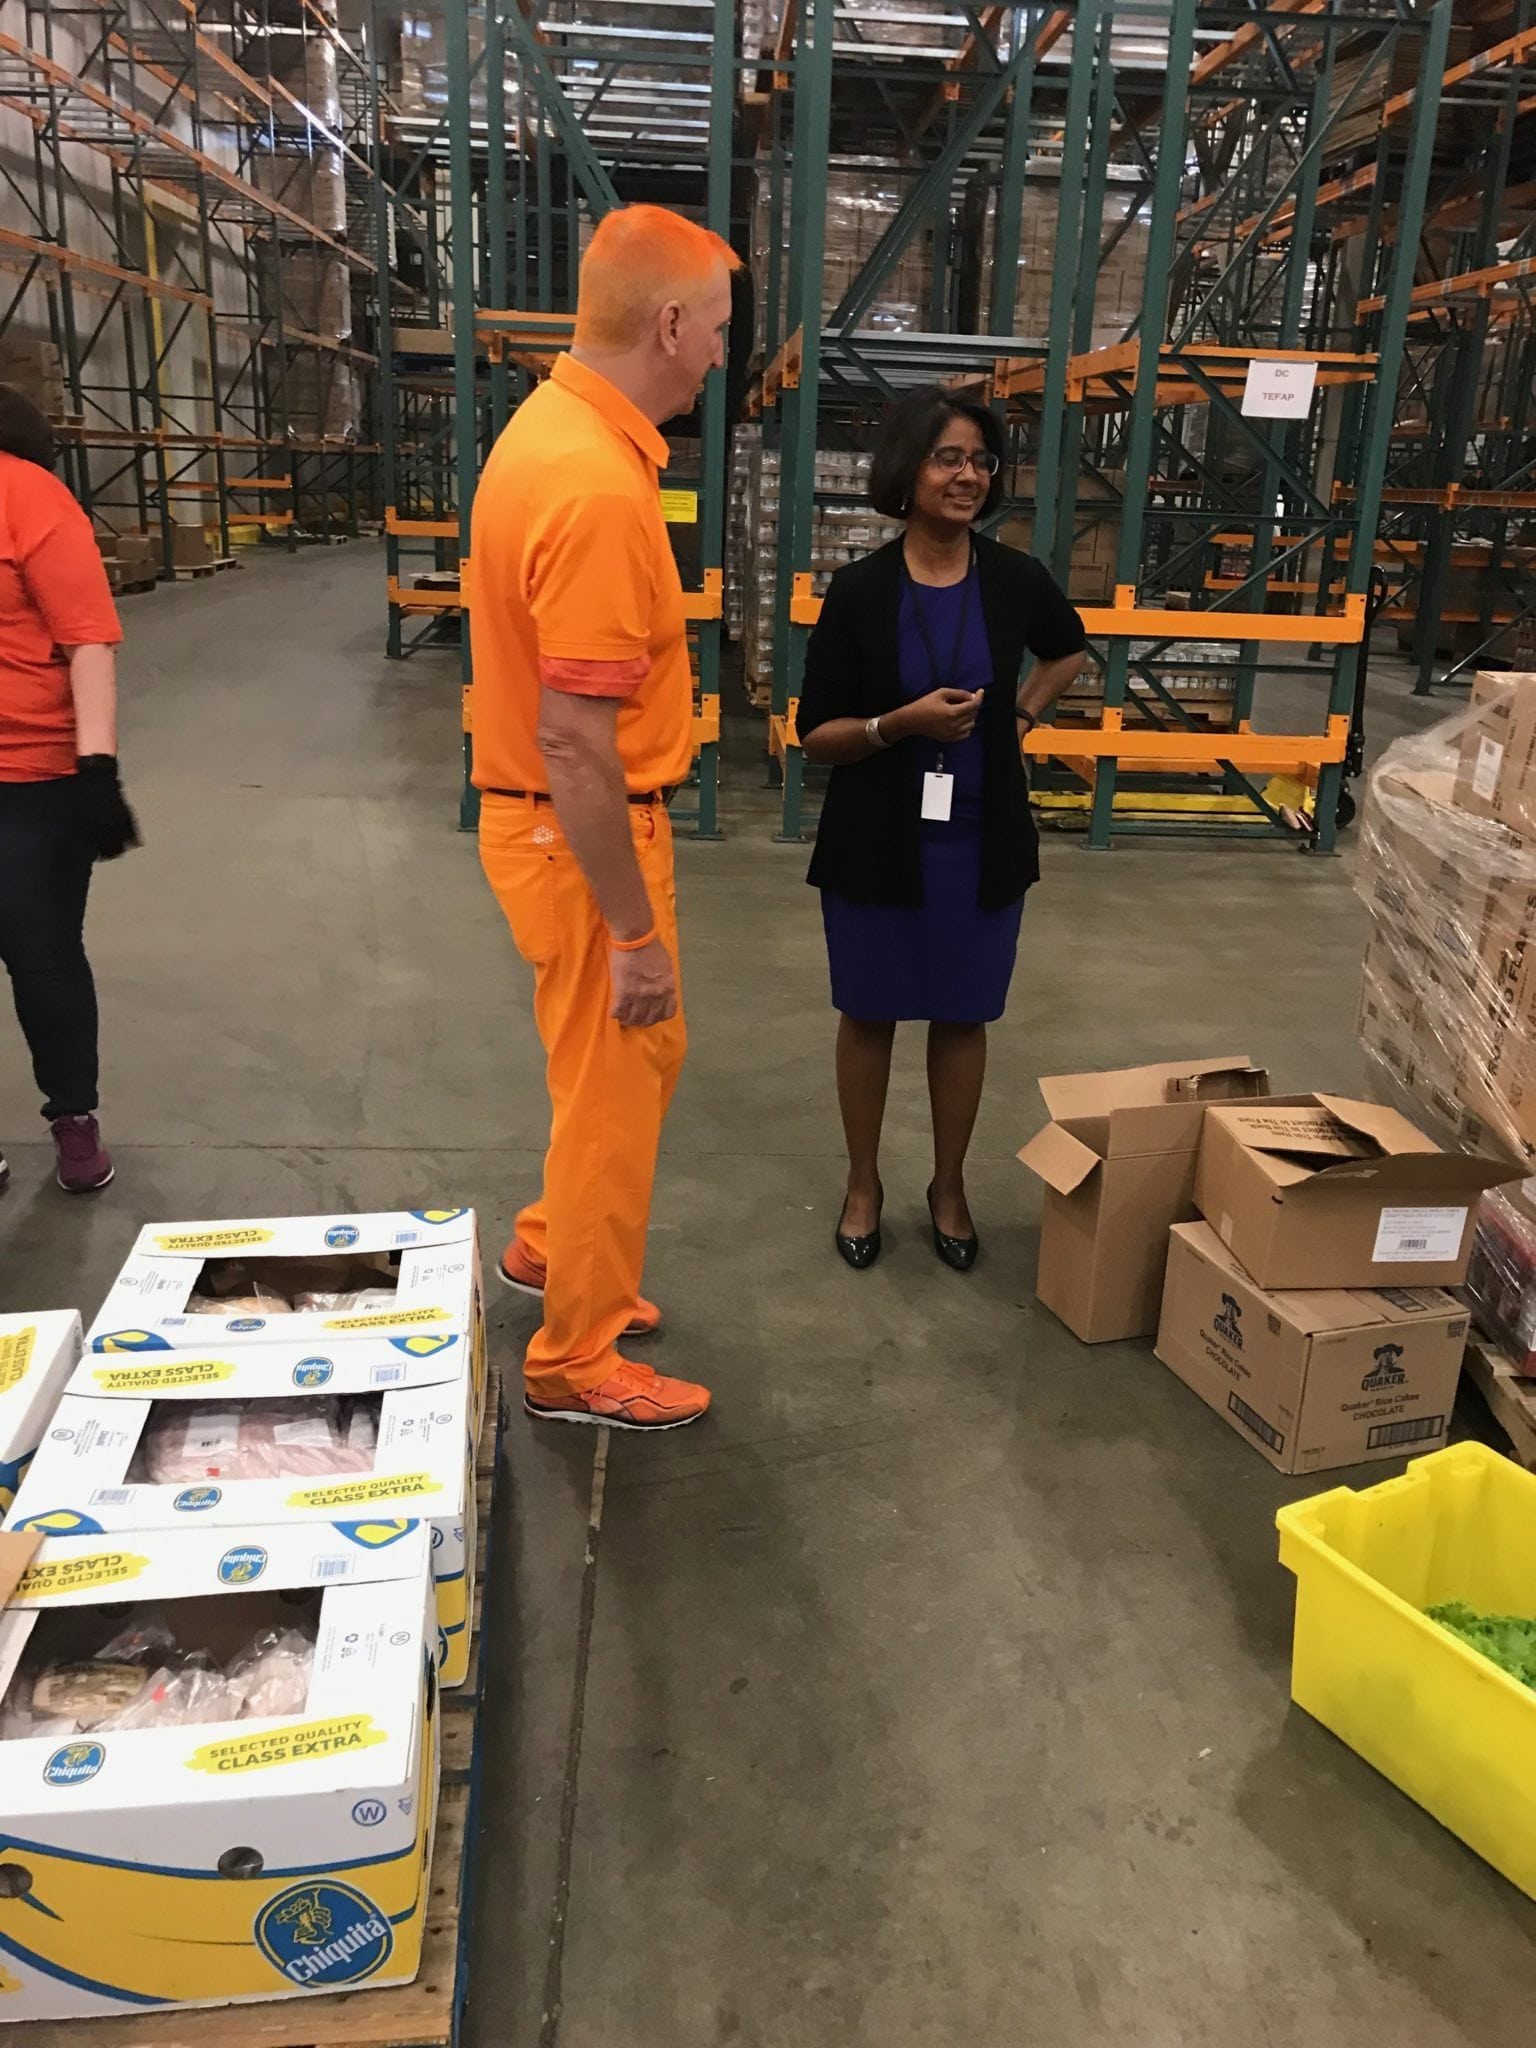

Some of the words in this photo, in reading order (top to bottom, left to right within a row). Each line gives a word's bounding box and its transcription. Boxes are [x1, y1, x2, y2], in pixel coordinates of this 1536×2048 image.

[1275, 369, 1290, 378] DC
[1262, 392, 1295, 401] TEFAP
[168, 1235, 213, 1244] EXTRA
[213, 1236, 263, 1247] SELECTED
[217, 1230, 258, 1241] CLASS
[167, 1240, 212, 1249] QUALITY
[334, 1316, 390, 1325] SELECTED
[391, 1309, 436, 1319] QUALITY
[341, 1321, 388, 1329] CLASS
[389, 1314, 436, 1325] EXTRA
[1214, 1317, 1243, 1350] QUAKER
[165, 1364, 214, 1376] CLASS
[1205, 1346, 1241, 1381] CHOCOLATE
[106, 1378, 158, 1388] QUALITY
[109, 1370, 161, 1381] EXTRA
[161, 1372, 220, 1384] SELECTED
[1361, 1373, 1406, 1391] QUAKER
[1375, 1397, 1393, 1406] Rice
[1394, 1393, 1420, 1403] Cakes
[1352, 1404, 1406, 1421] CHOCOLATE
[303, 1485, 367, 1499] SELECTED
[369, 1475, 425, 1490] QUALITY
[310, 1492, 365, 1507] CLASS
[368, 1482, 426, 1498] EXTRA
[175, 1499, 217, 1509] Chiquita
[62, 1554, 122, 1575] CLASS
[222, 1553, 266, 1564] Chiquita
[21, 1566, 57, 1581] EXT
[57, 1566, 128, 1586] SELECTED
[15, 1577, 52, 1592] QUAL
[209, 1736, 290, 1759] SELECTED
[294, 1720, 363, 1743] QUALITY
[217, 1748, 287, 1772] CLASS
[292, 1732, 363, 1757] EXTRA
[44, 1764, 99, 1780] Chiquita
[359, 1806, 380, 1822] W
[286, 1916, 389, 1983] Chiquita
